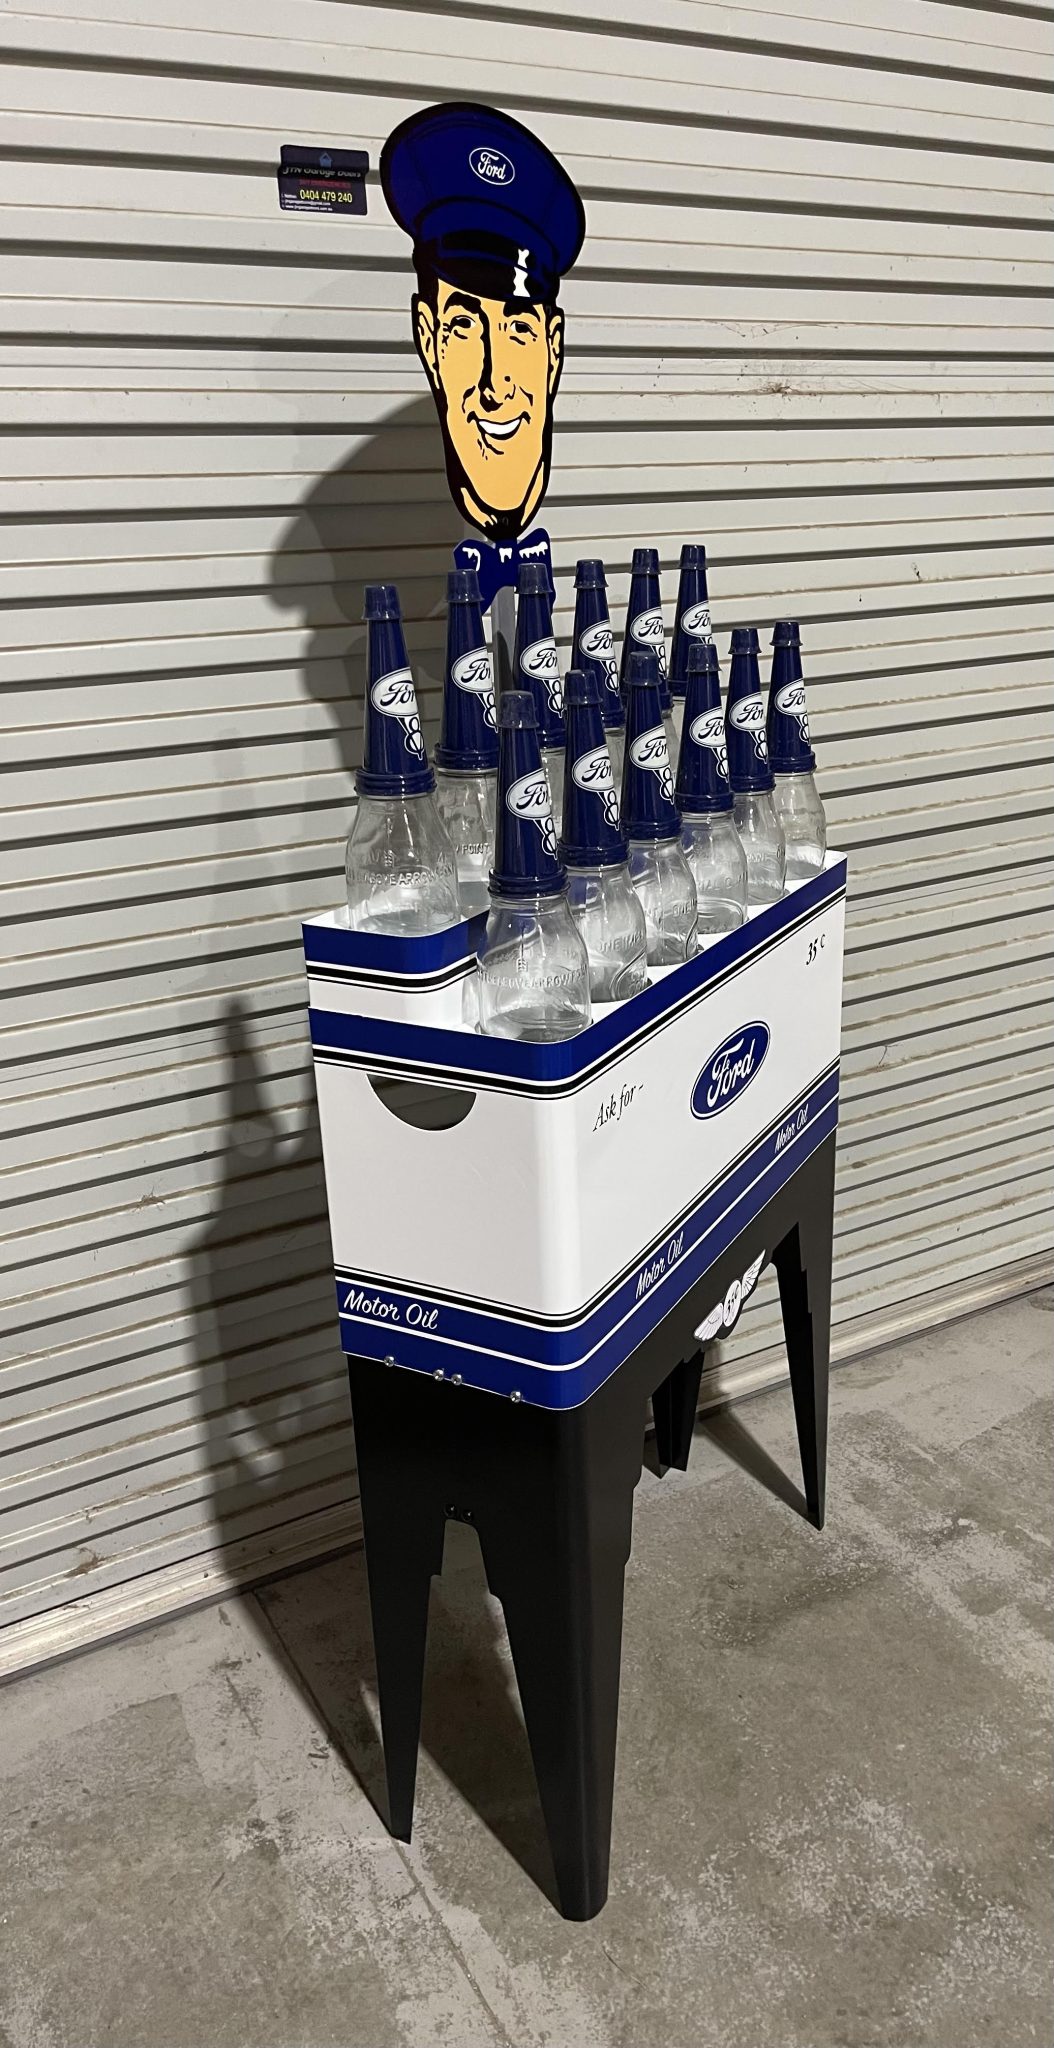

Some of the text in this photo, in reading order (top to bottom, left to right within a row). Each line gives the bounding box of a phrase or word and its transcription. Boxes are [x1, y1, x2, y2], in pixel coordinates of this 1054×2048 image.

[477, 151, 506, 180] Ford
[300, 189, 319, 200] 0404
[321, 191, 336, 202] 479
[338, 192, 353, 203] 240
[806, 937, 819, 966] 35
[707, 1037, 756, 1108] Ford
[592, 1093, 617, 1132] Ask
[616, 1083, 636, 1121] for
[774, 1103, 809, 1154] Motor Oil
[635, 1230, 684, 1300] Motor Oil
[343, 1289, 439, 1330] Motor Oil
